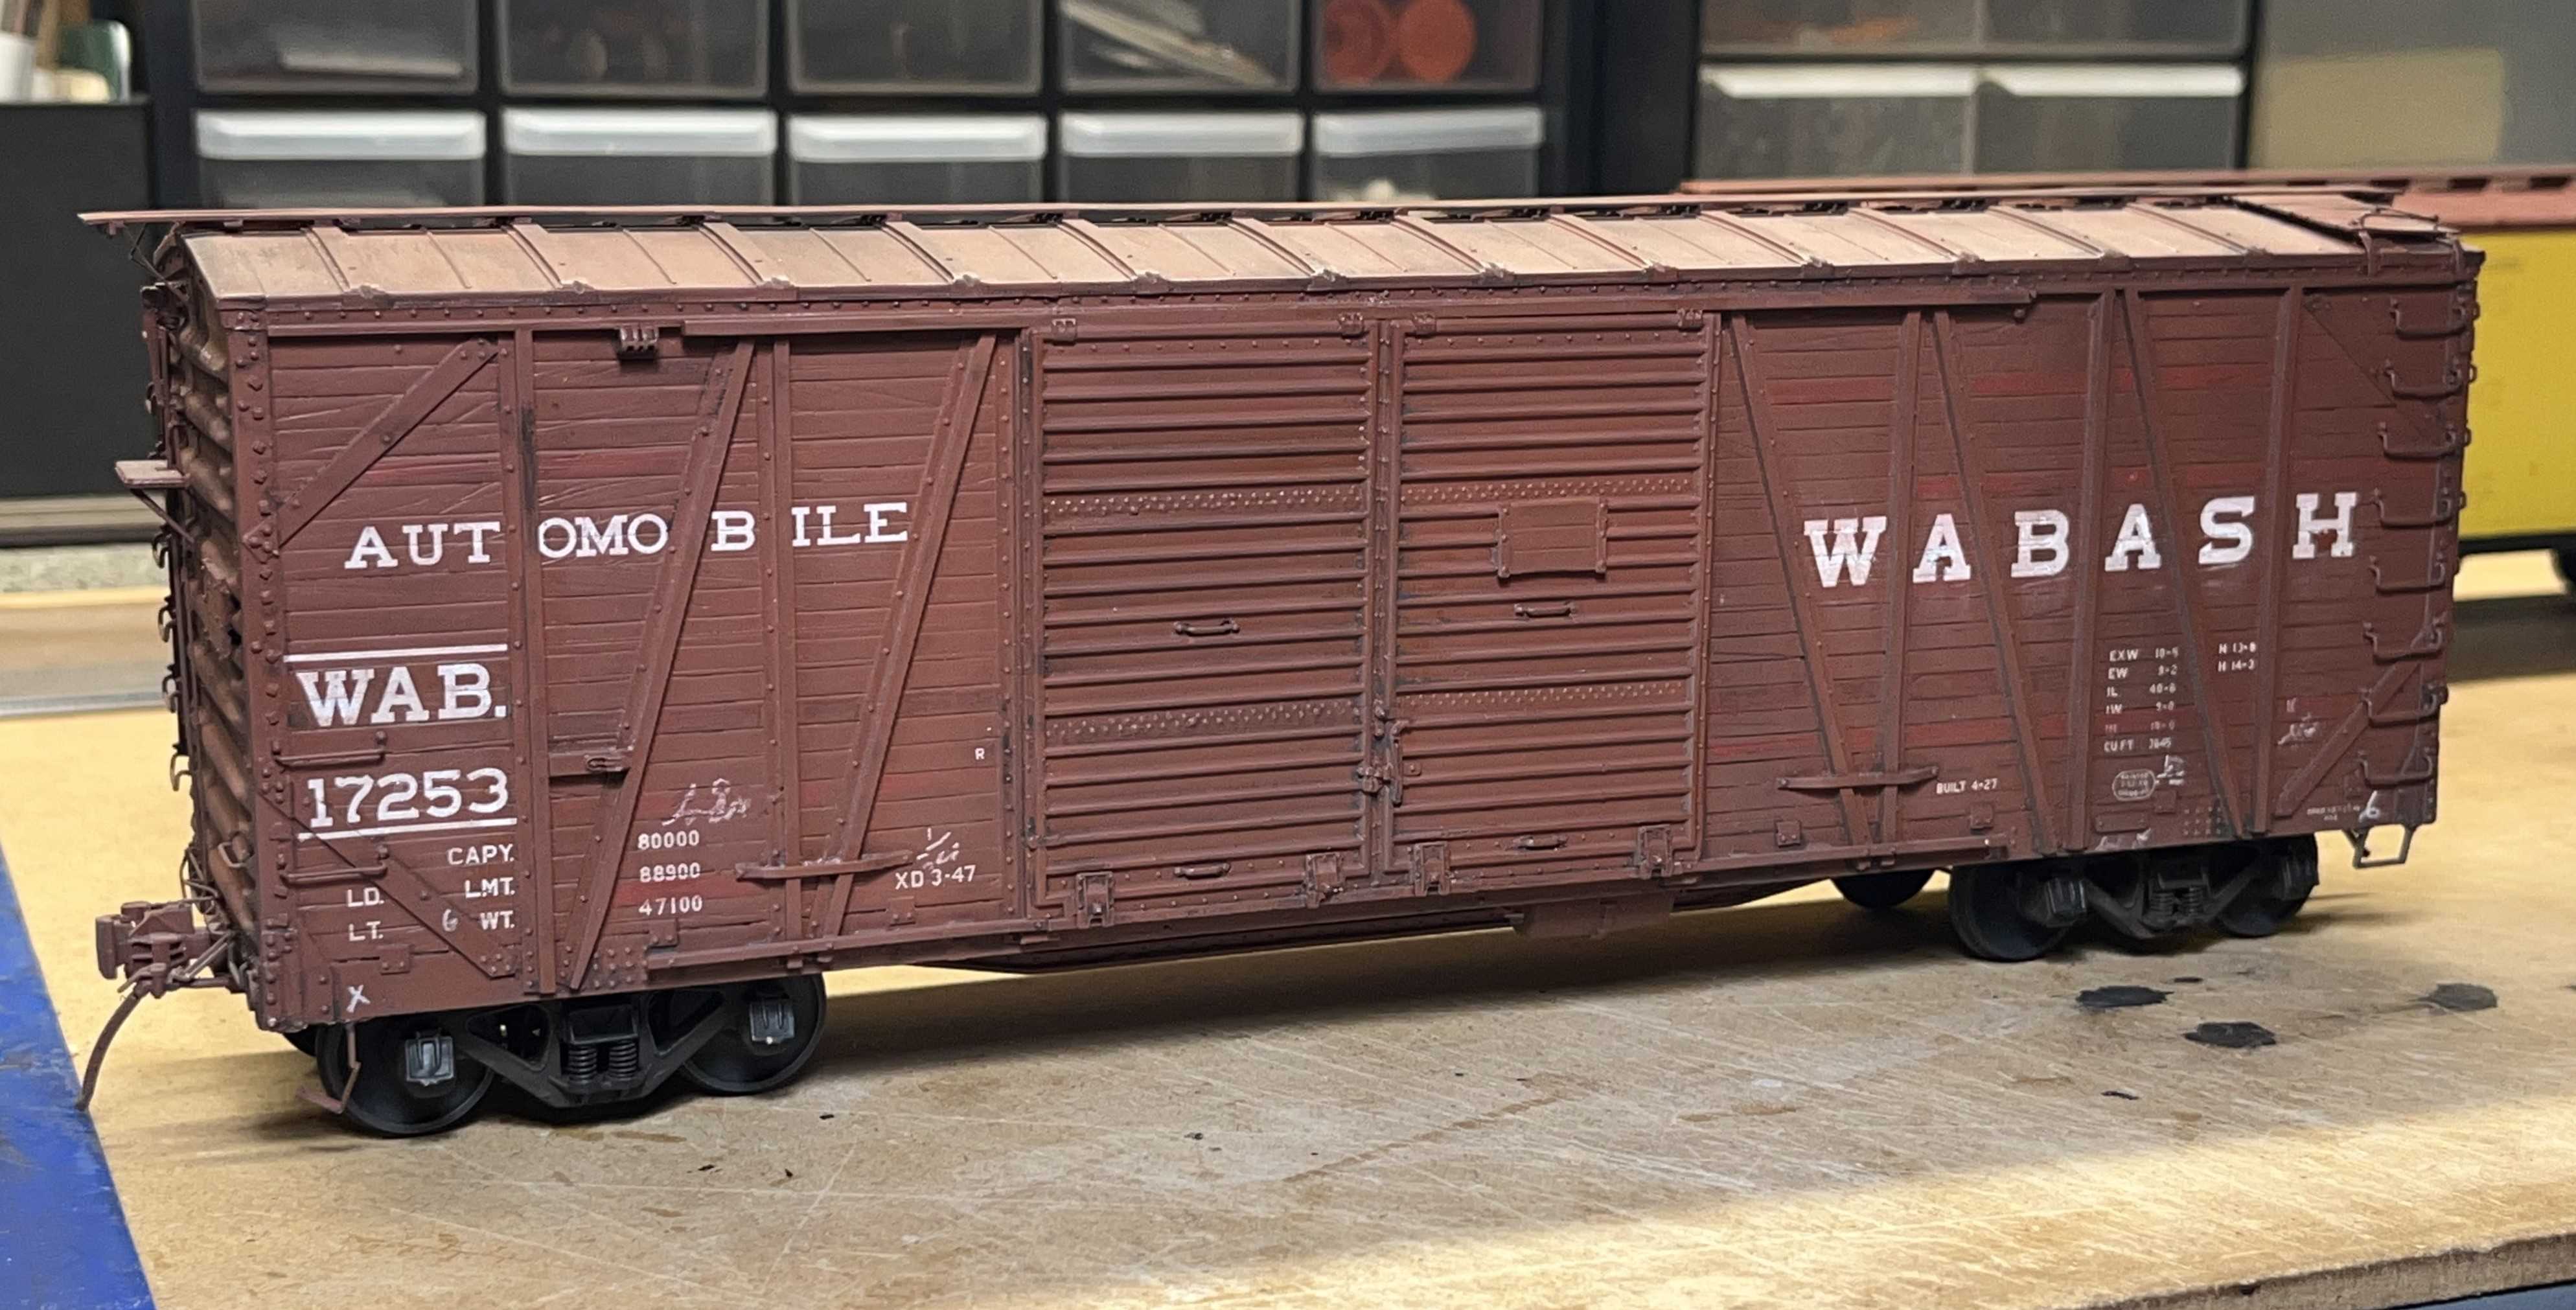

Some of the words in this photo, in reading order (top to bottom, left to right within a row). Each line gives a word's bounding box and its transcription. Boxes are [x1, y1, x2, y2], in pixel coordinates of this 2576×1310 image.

[1804, 492, 2358, 588] WABASH
[2109, 649, 2139, 662] EXW
[2108, 666, 2128, 680] EW
[295, 662, 508, 728] WAB.
[2106, 686, 2118, 698] IL
[2106, 704, 2122, 715] IW
[974, 748, 985, 760] R
[307, 768, 508, 827] 17253
[1936, 780, 1966, 795] BUILT
[1971, 777, 1998, 791] 4-27
[447, 844, 516, 866] CAPY.
[637, 829, 700, 851] 80000
[345, 886, 385, 907] LD.
[639, 862, 702, 884] 88900
[895, 870, 924, 890] XD
[931, 864, 977, 887] 3-47
[348, 920, 384, 941] LT.
[479, 910, 516, 930] WT.
[638, 894, 704, 917] 47100
